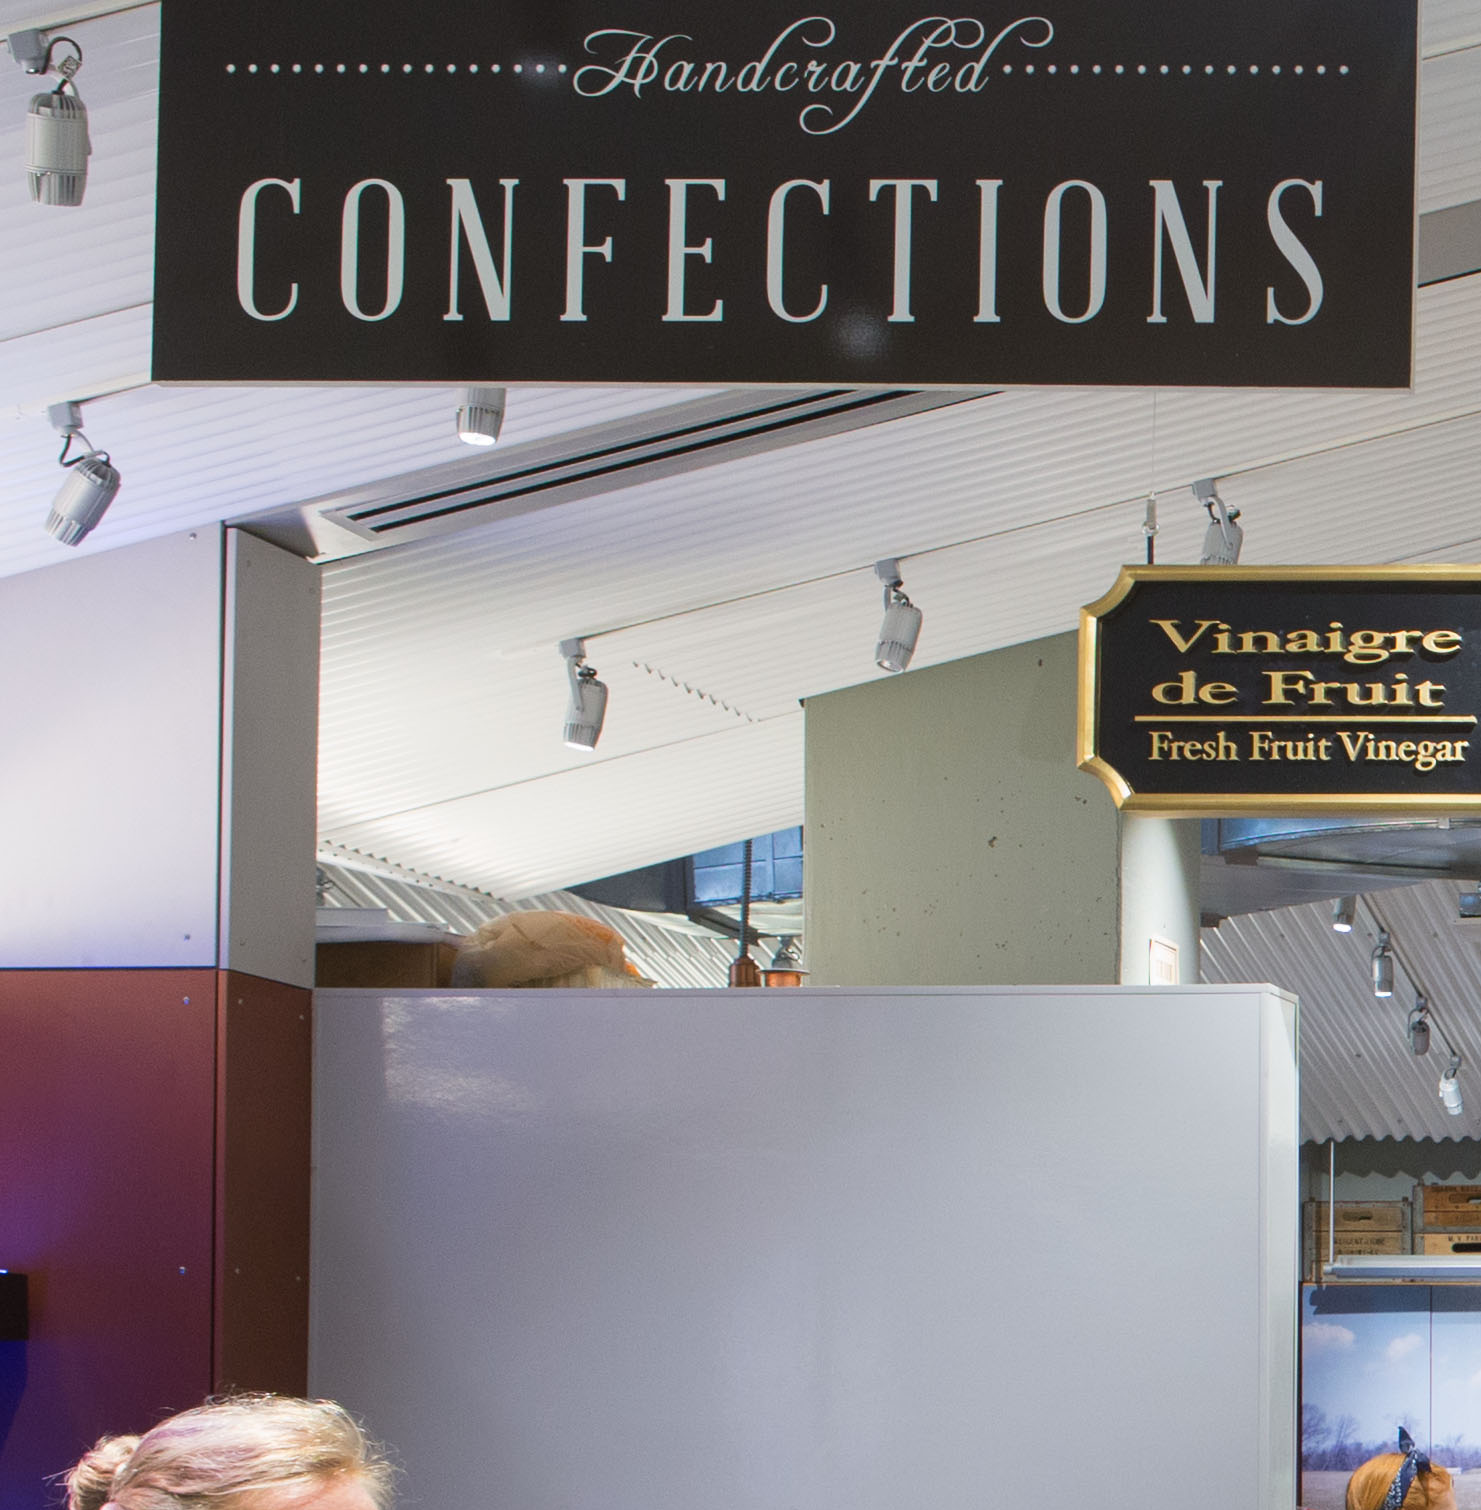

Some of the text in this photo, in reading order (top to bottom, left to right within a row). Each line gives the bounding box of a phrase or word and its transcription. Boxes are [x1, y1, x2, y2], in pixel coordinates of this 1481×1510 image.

[572, 15, 1053, 135] Handcrafted
[234, 176, 1326, 326] CONFECTIONS
[1150, 619, 1462, 663] Vinaigre
[1151, 670, 1447, 710] de Fruit
[1148, 730, 1469, 771] Fresh Fruit Vinegar
